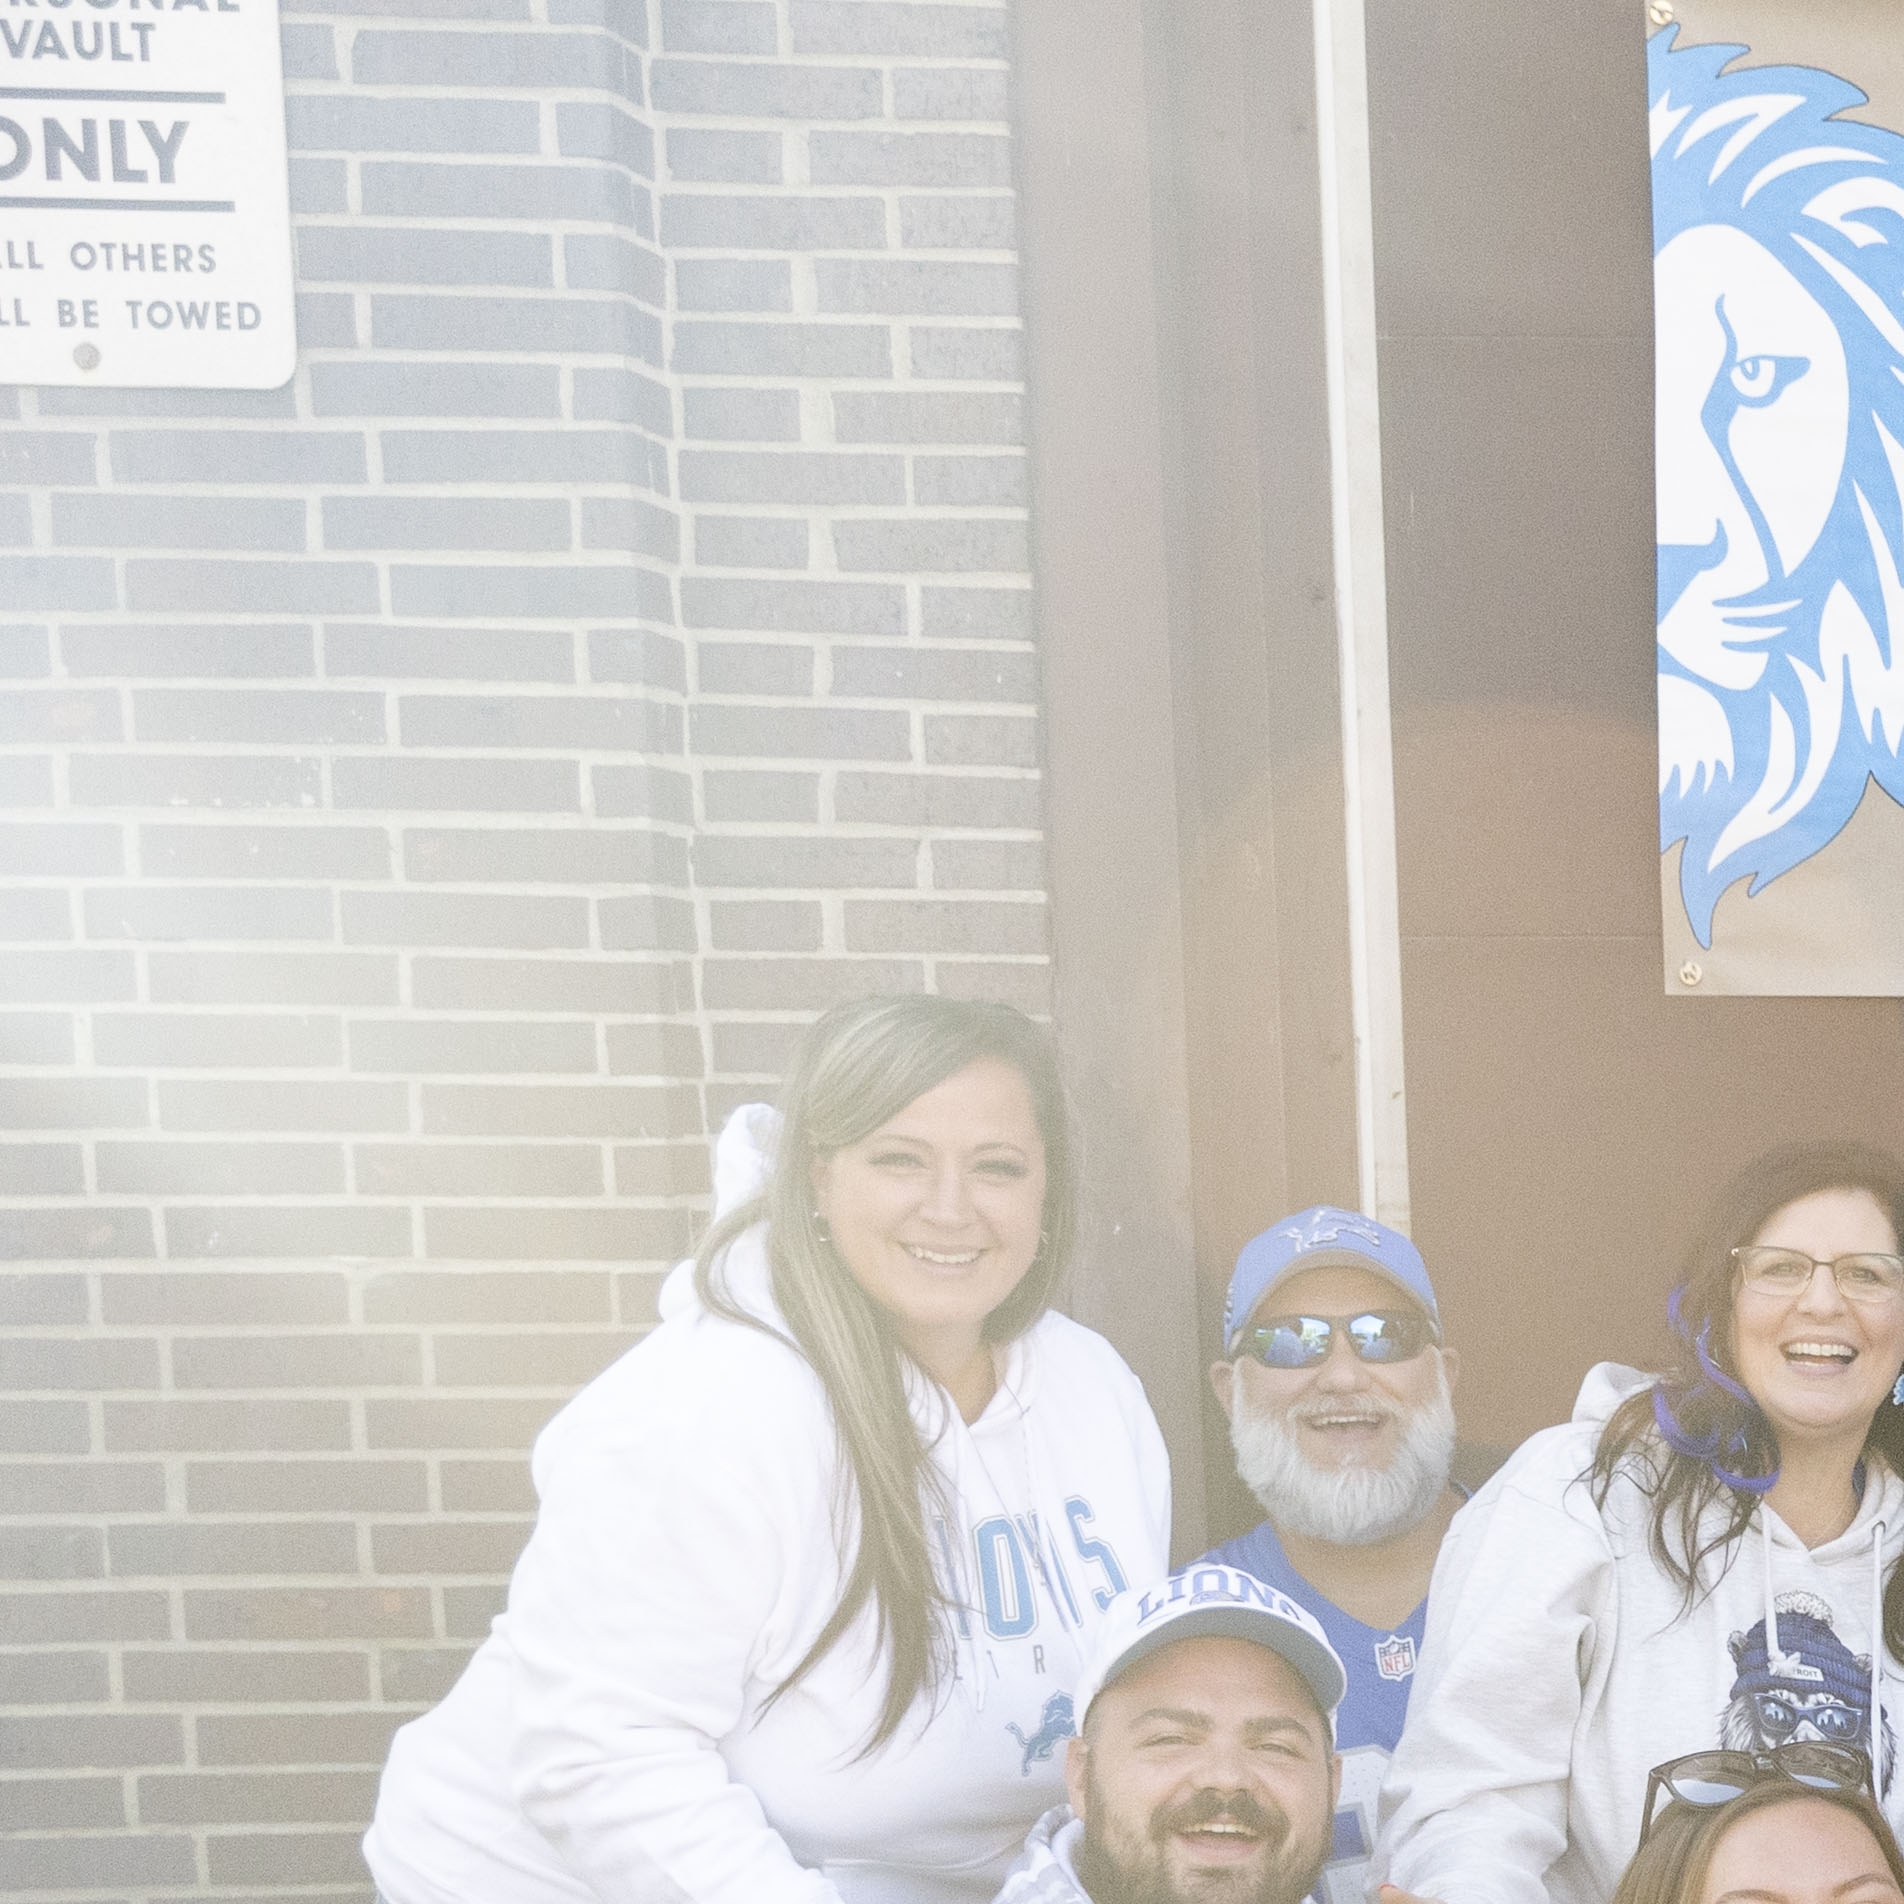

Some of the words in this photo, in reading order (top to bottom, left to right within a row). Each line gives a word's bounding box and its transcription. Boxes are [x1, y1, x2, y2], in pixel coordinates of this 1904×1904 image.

[0, 19, 156, 62] VAULT
[70, 242, 217, 273] OTHERS
[57, 299, 100, 328] BE
[125, 300, 262, 330] TOWED
[1383, 1653, 1410, 1673] NFL
